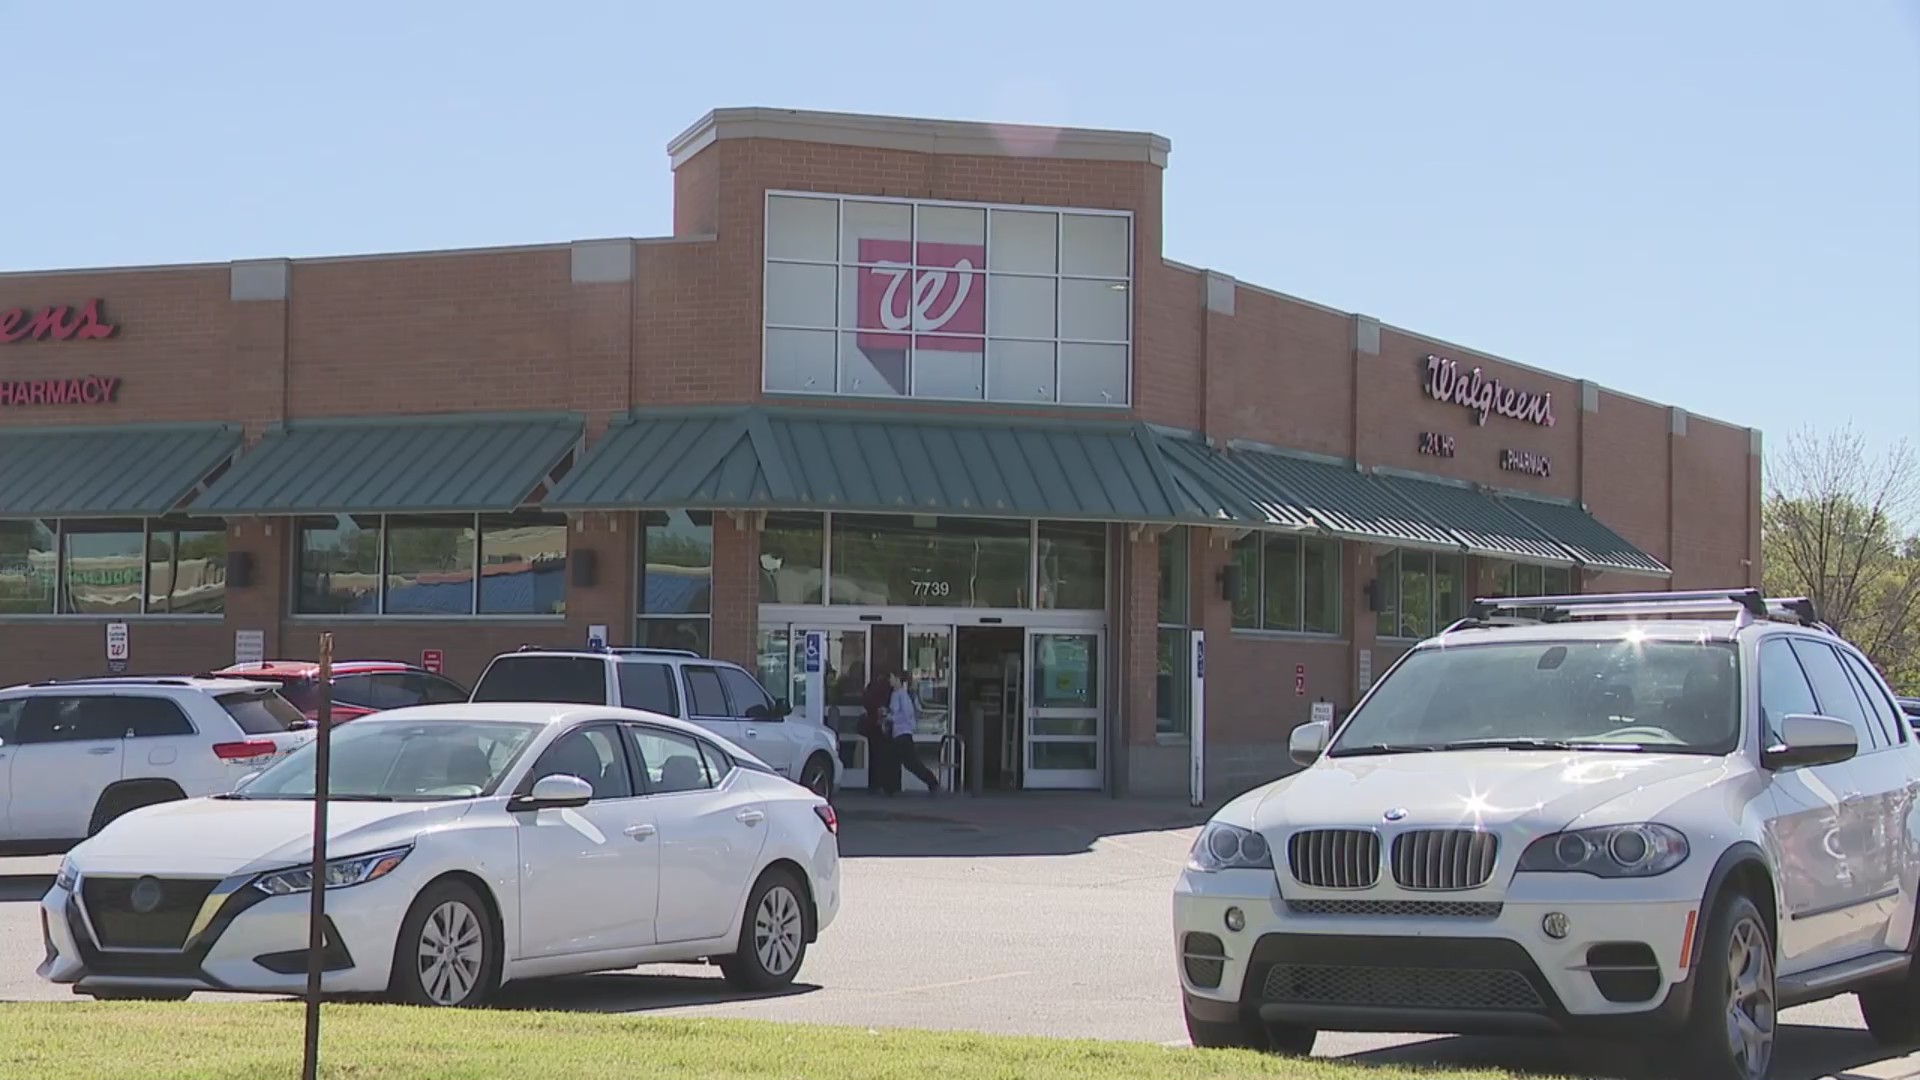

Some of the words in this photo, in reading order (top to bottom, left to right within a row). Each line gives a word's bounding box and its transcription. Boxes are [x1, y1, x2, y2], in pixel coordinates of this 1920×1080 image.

[1426, 354, 1556, 428] Walgreens
[1505, 448, 1552, 477] PHARMACY
[911, 580, 950, 596] 7739
